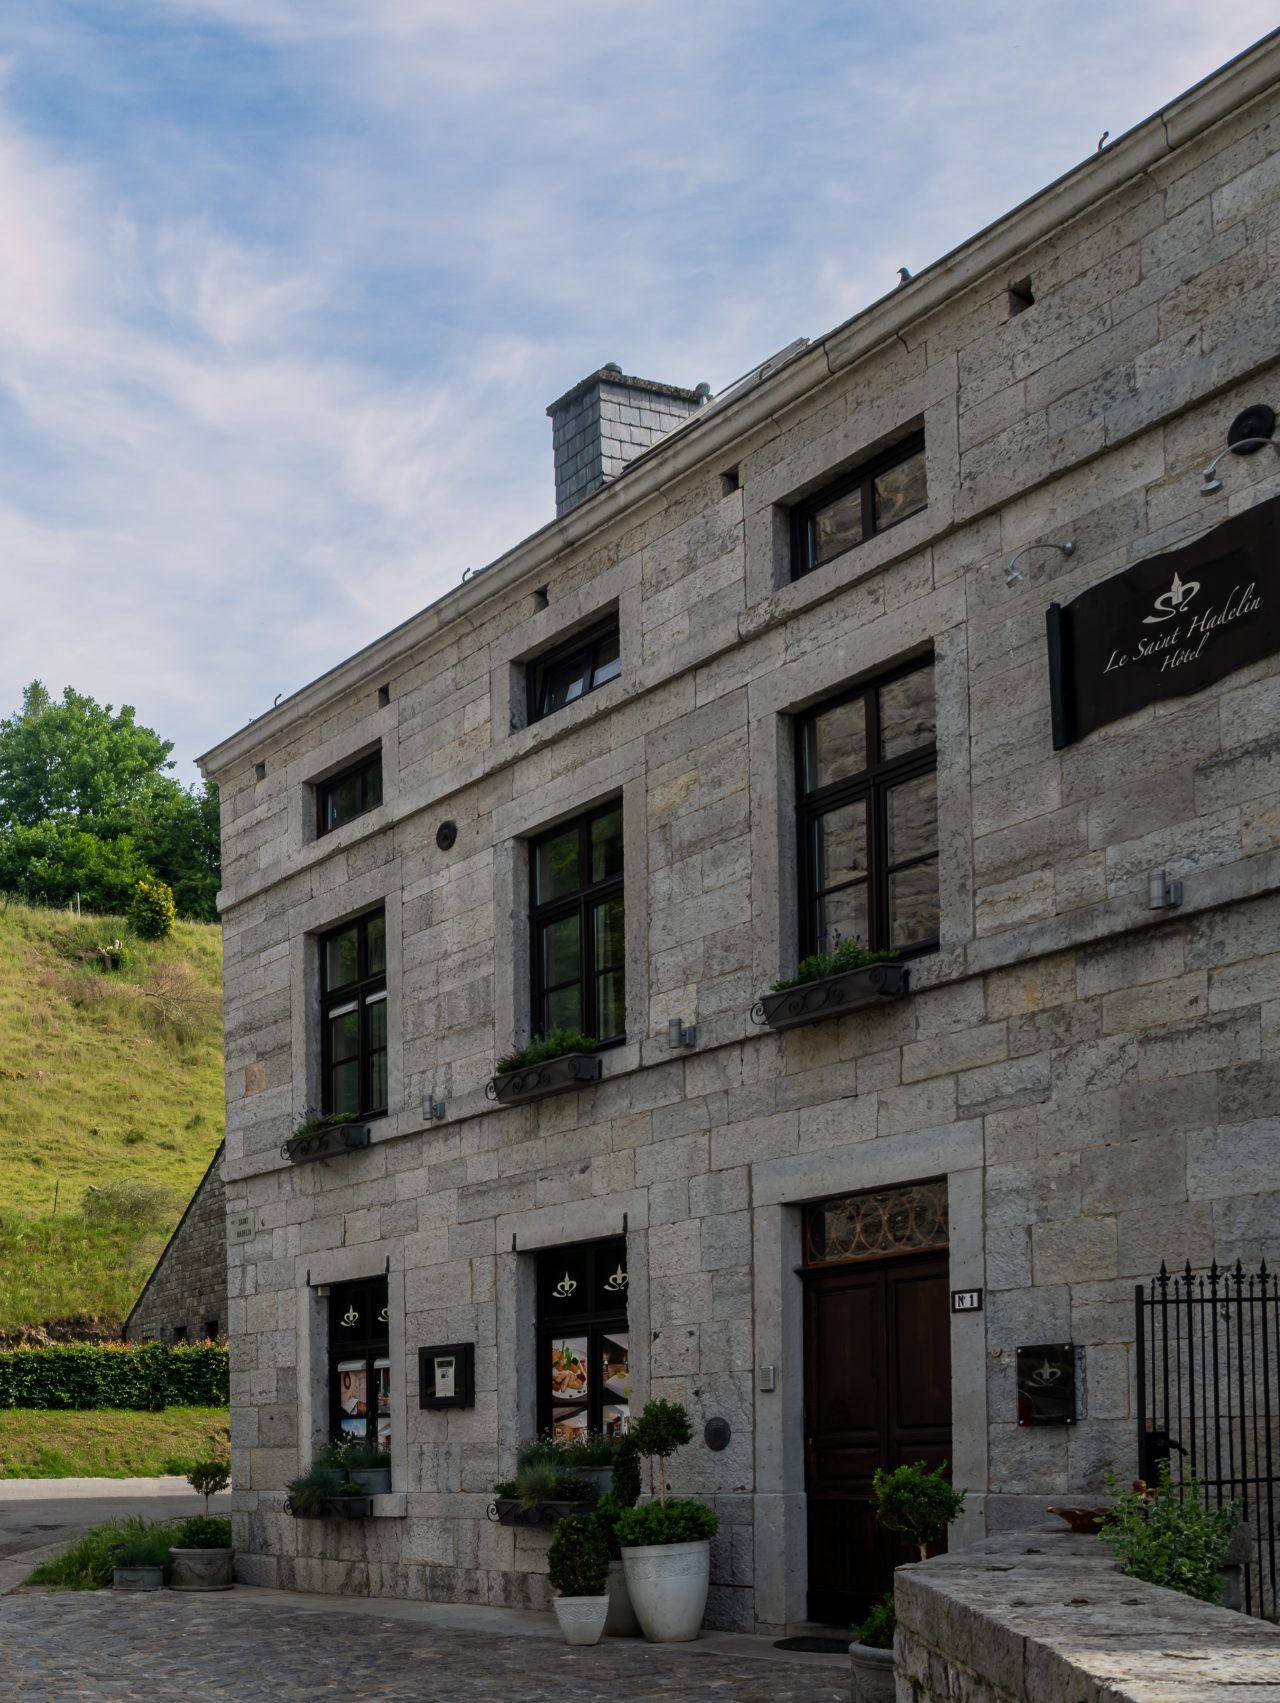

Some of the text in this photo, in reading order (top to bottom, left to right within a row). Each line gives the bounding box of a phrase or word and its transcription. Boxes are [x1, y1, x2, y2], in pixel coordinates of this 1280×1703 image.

[1103, 582, 1263, 674] Le Saint Hadelin
[1161, 632, 1210, 673] Hôtel
